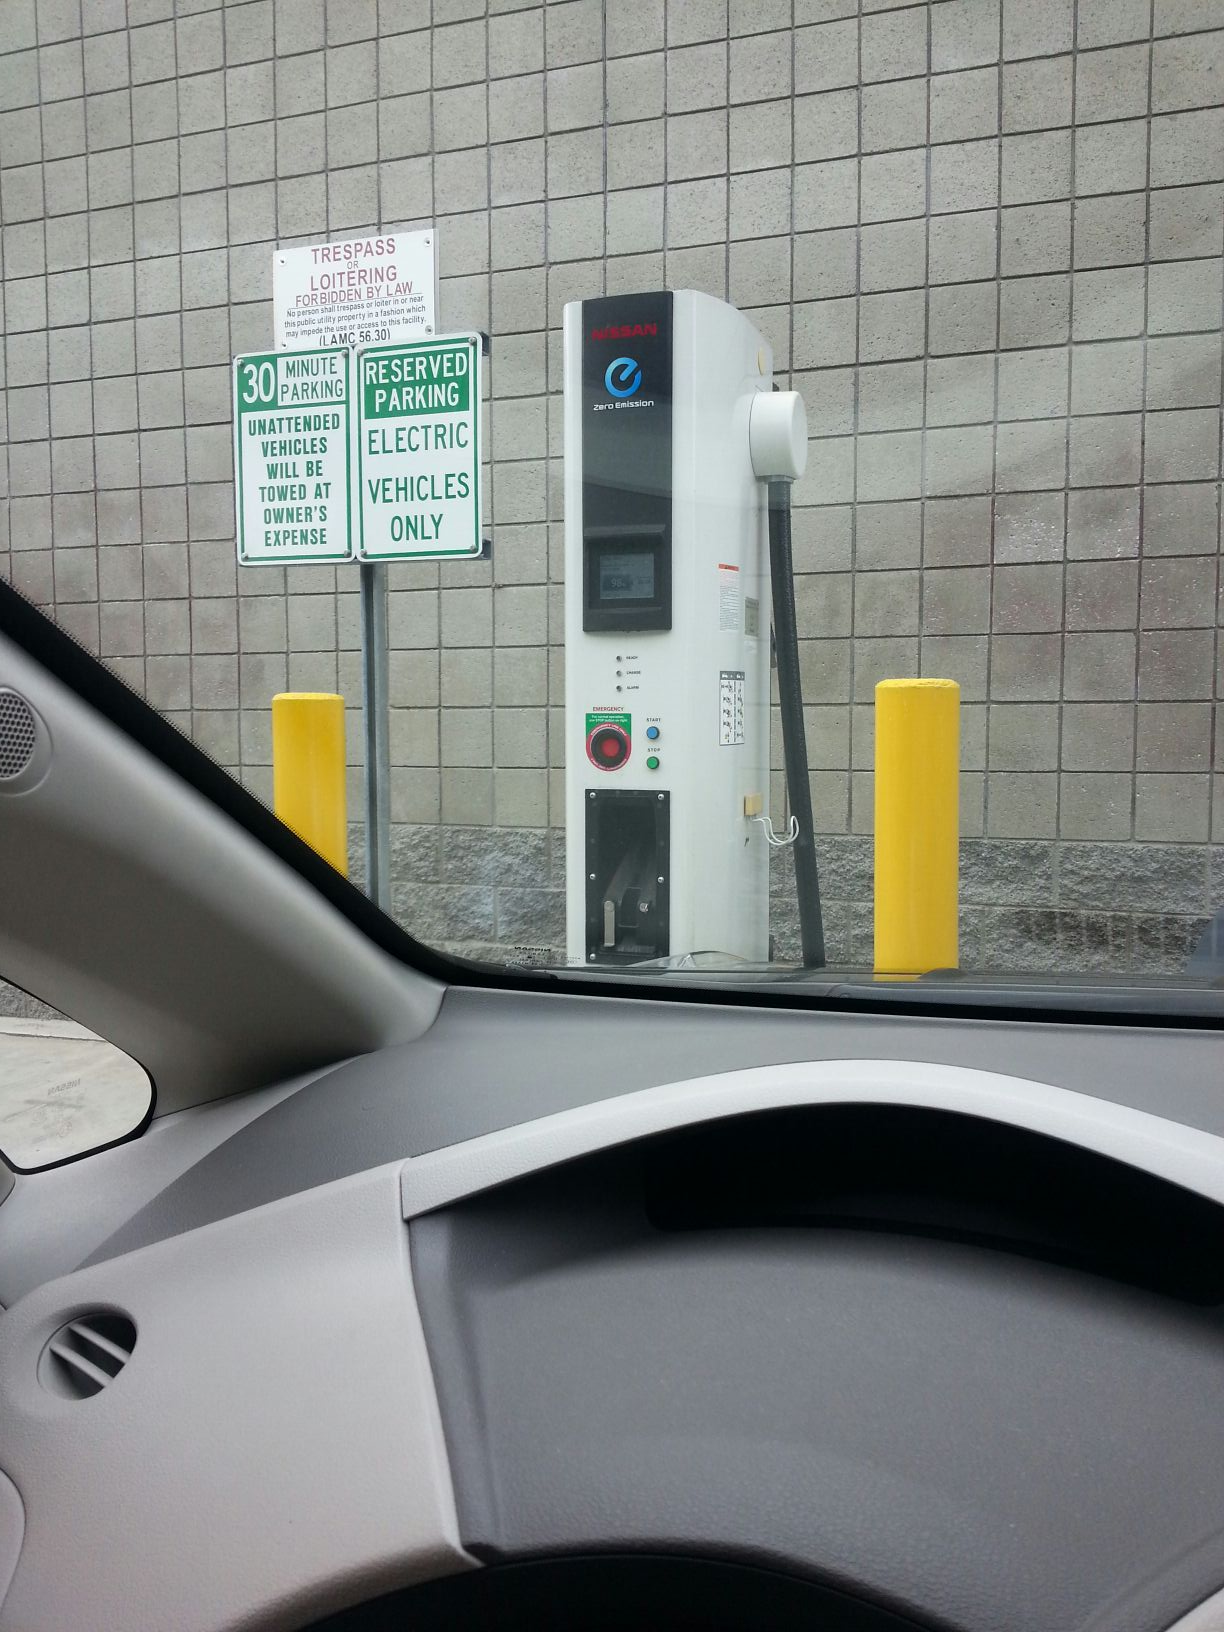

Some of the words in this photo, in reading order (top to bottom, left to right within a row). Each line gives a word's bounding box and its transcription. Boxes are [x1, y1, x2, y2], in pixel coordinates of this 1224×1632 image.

[311, 238, 396, 264] TRESPASS
[347, 260, 359, 270] OR
[311, 265, 397, 292] LOITERING
[296, 287, 362, 308] FORBIDDEN
[367, 285, 382, 299] BY
[386, 281, 413, 296] LAW
[284, 320, 296, 328] this
[297, 318, 316, 328] public
[317, 315, 336, 324] utility
[337, 313, 366, 323] property
[367, 311, 373, 319] in
[380, 308, 405, 317] fashion
[406, 304, 426, 314] which
[297, 308, 319, 318] person
[320, 305, 336, 314] shall
[336, 303, 365, 312] trespass
[374, 299, 392, 307] loiter
[392, 297, 399, 305] in
[409, 295, 424, 303] near
[286, 330, 299, 339] may
[300, 327, 323, 337] impede
[324, 325, 335, 333] the
[356, 321, 379, 330] access
[388, 317, 401, 326] this
[319, 332, 356, 347] (LAMC
[359, 328, 391, 343] 56.30)
[591, 322, 658, 341] NISSAN
[285, 356, 338, 379] MINUTE
[365, 352, 468, 385] RESERVED
[242, 361, 276, 404] 30
[281, 378, 344, 402] PARKING
[375, 382, 459, 413] PARKING
[615, 399, 655, 409] Emission
[248, 413, 340, 437] UNATTENDED
[261, 436, 328, 458] VEHICLES
[367, 421, 469, 455] ELECTRIC
[266, 461, 299, 480] WILL
[306, 460, 323, 478] BE
[258, 483, 307, 502] TOWED
[314, 482, 332, 500] AT
[367, 472, 470, 504] VEHICLES
[263, 505, 328, 525] OWNER'S
[264, 528, 327, 547] EXPENSE
[390, 513, 444, 542] ONLY
